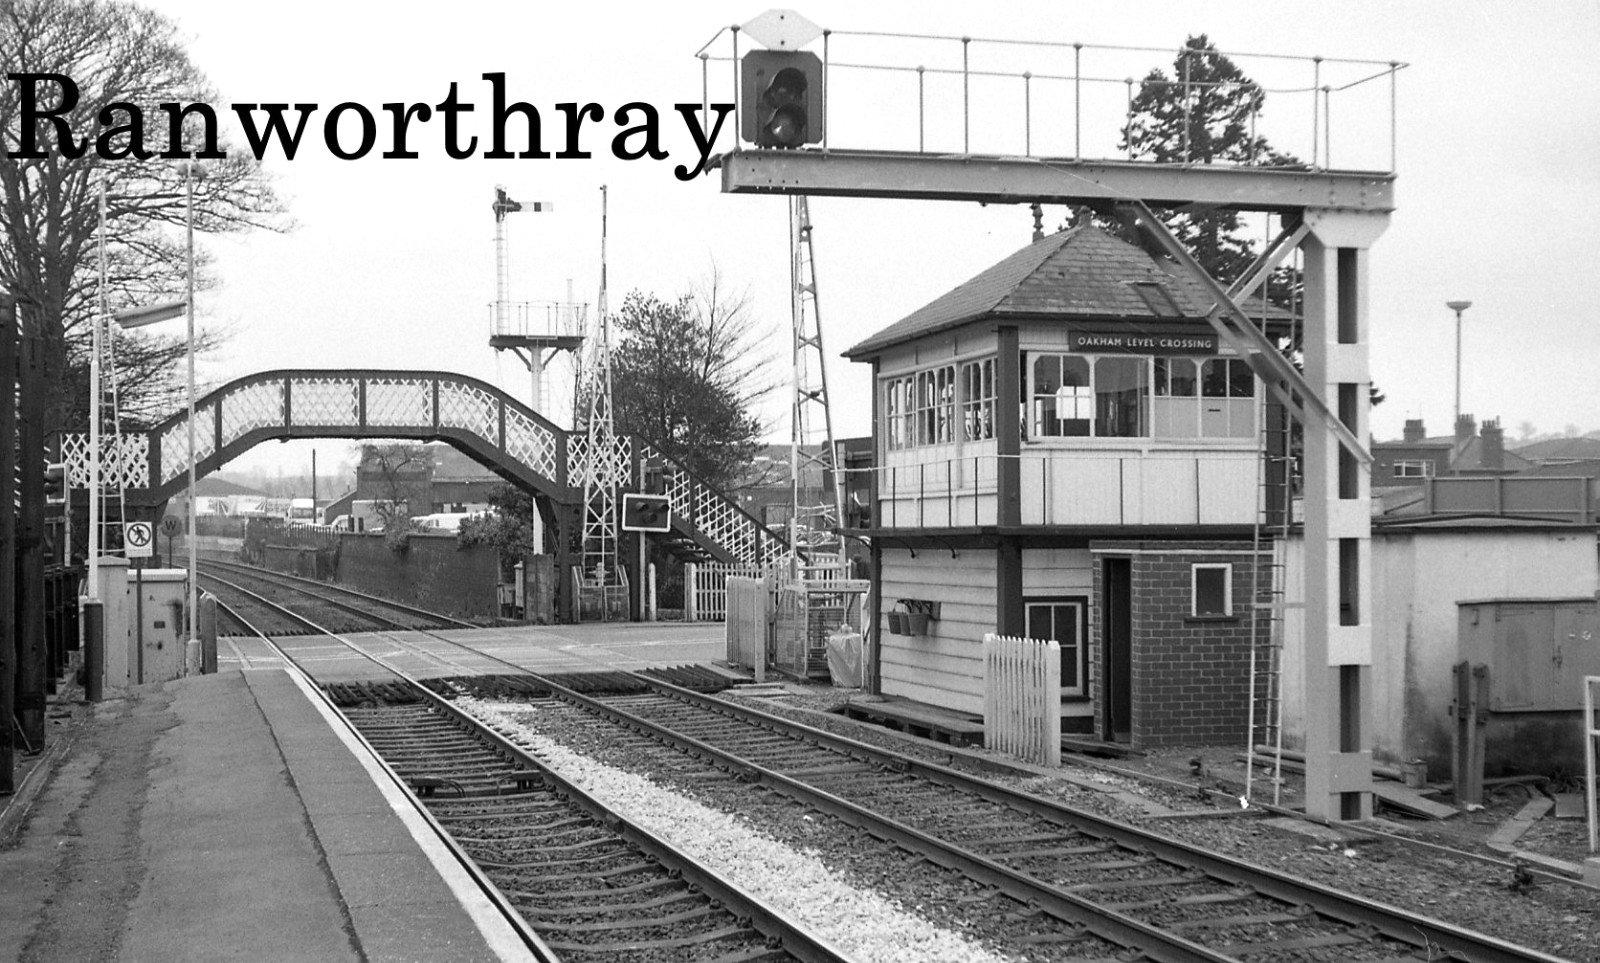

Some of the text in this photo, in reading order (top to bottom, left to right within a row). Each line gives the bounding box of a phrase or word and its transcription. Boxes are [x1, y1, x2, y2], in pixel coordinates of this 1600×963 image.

[1077, 336, 1212, 349] OAKHAM LEVEL CROSSING
[165, 520, 177, 531] W
